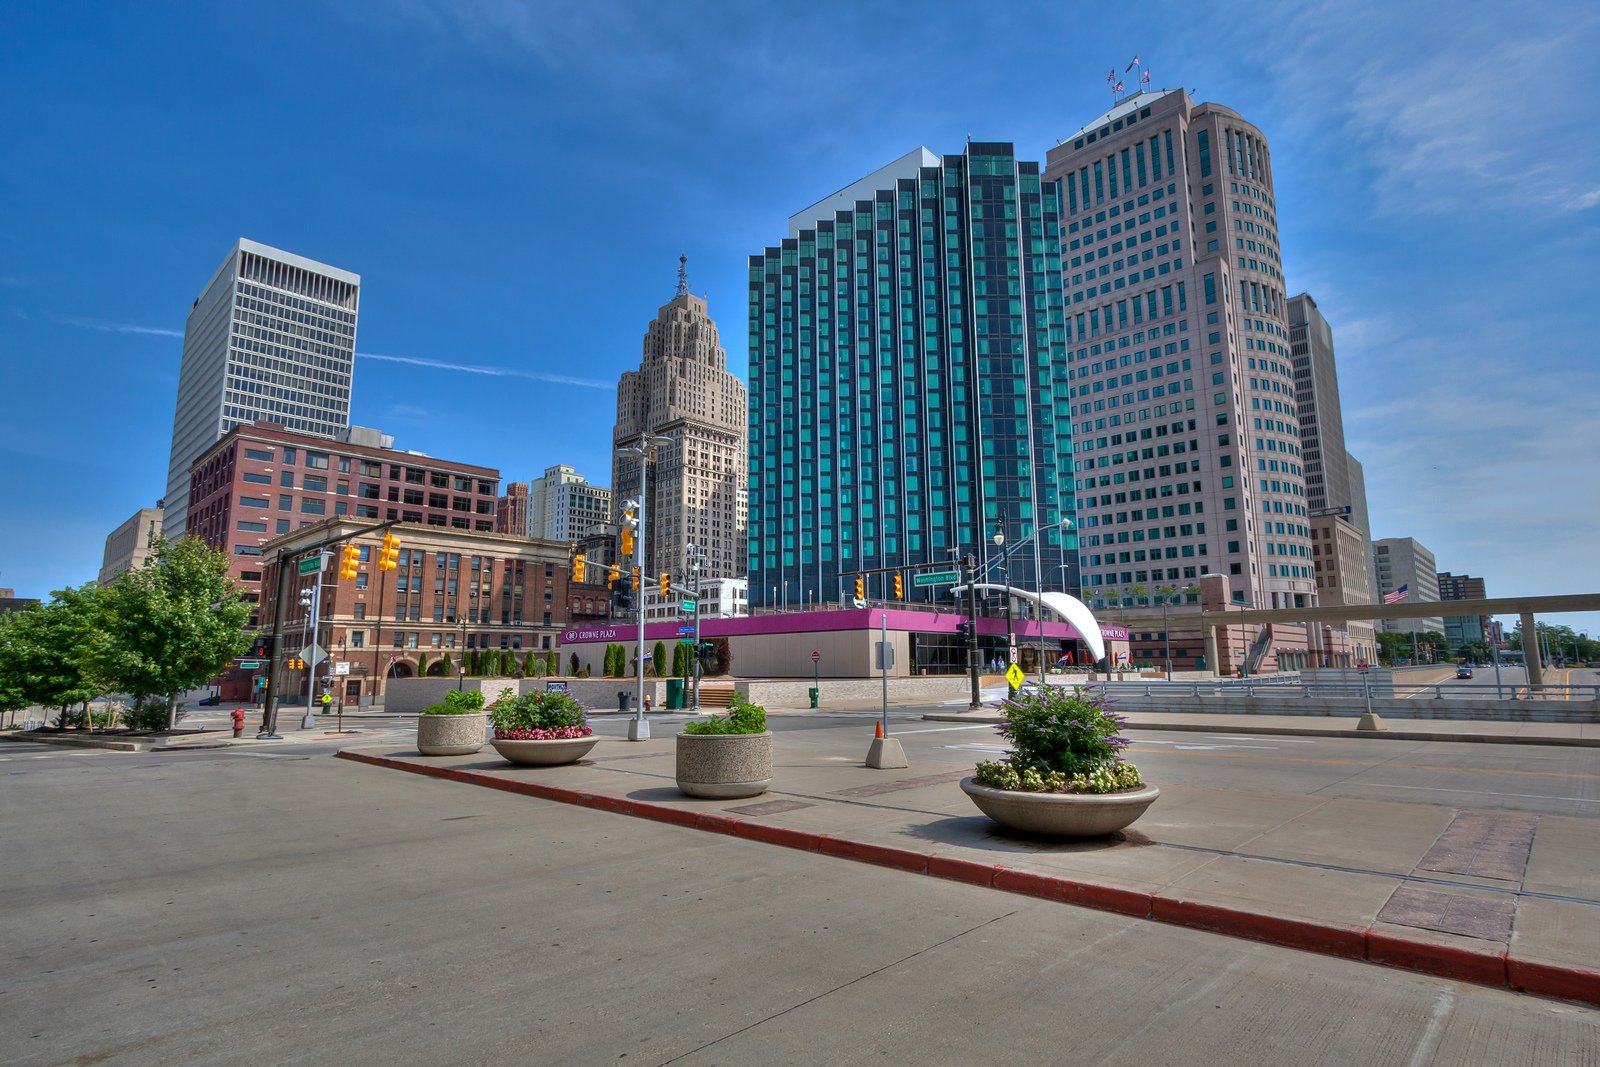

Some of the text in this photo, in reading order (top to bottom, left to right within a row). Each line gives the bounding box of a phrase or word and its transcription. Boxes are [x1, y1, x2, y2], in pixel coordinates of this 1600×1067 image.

[916, 573, 957, 584] Washington Blvd
[579, 629, 616, 639] CROWNE PLAZA
[1101, 629, 1114, 638] ROWNE
